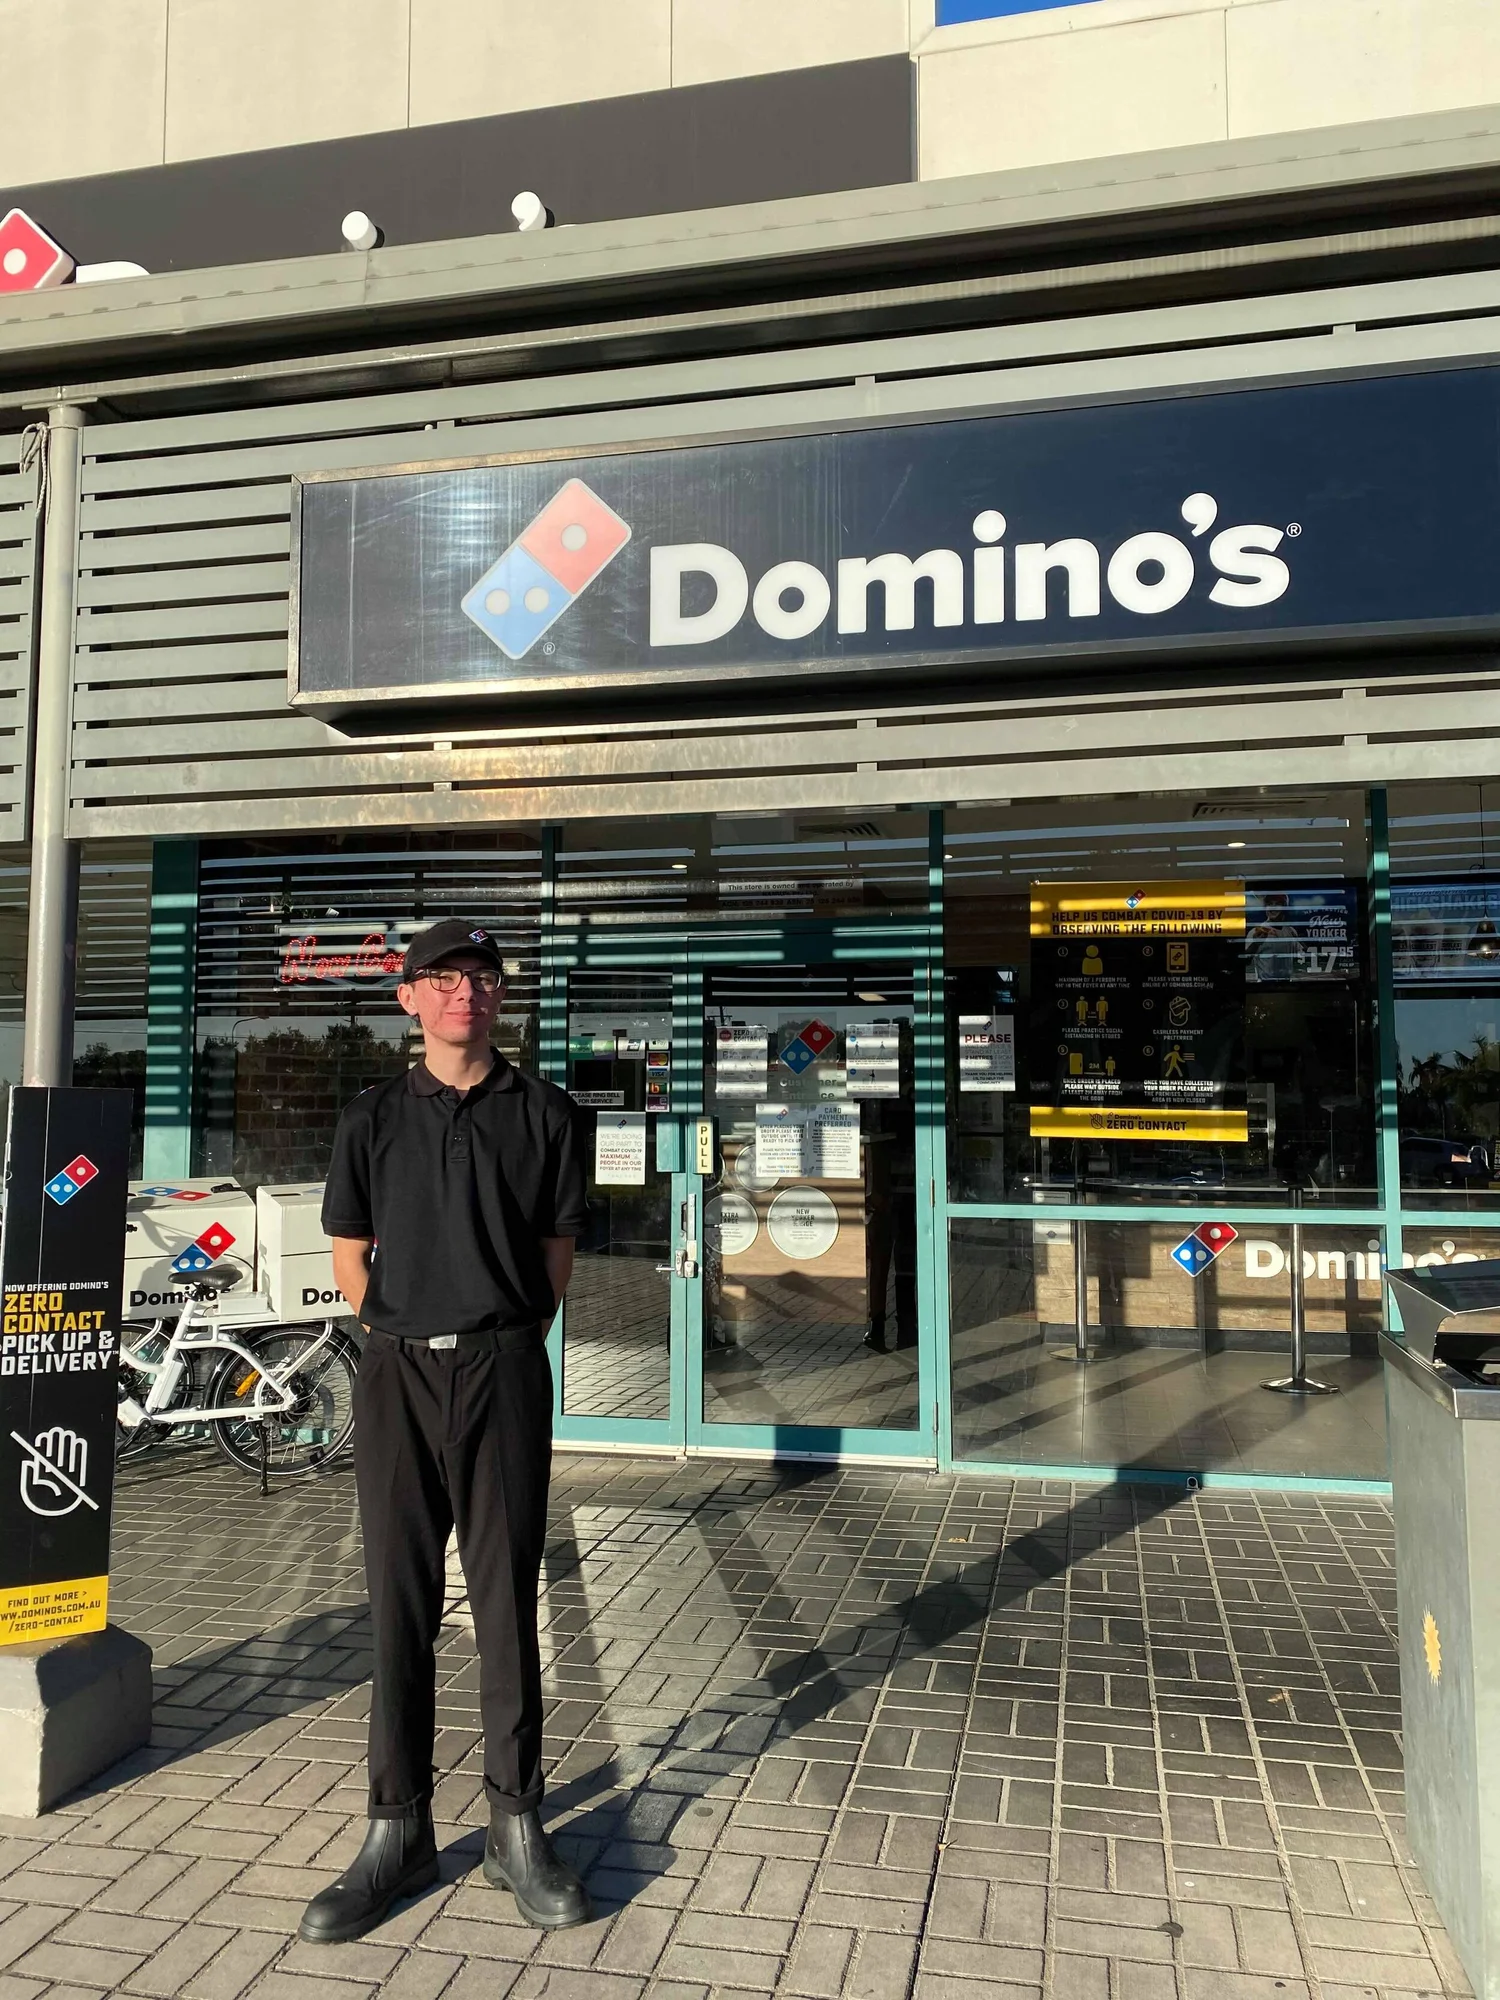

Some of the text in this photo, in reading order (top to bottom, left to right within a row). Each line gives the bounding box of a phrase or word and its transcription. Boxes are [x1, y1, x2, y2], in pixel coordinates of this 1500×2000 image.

[650, 492, 1289, 647] Domino's
[1052, 910, 1223, 922] HELP US COMBAT COVID-19 BY
[1309, 915, 1344, 928] New
[1053, 924, 1222, 936] OBSERVING THE FOLLOWING
[1306, 928, 1347, 938] YORKER
[965, 1034, 1012, 1043] PLEASE
[1106, 1120, 1187, 1131] ZERO CONTACT
[700, 1126, 708, 1167] PULL
[5, 1282, 109, 1292] NOW OFFERING DOMINO'S
[4, 1292, 62, 1312] ZERO
[4, 1310, 106, 1334] CONTACT
[2, 1330, 115, 1354] PICK UP &
[8, 1591, 79, 1608] FIND OUT MORE
[8, 1614, 84, 1633] /ZERO-CONTACT
